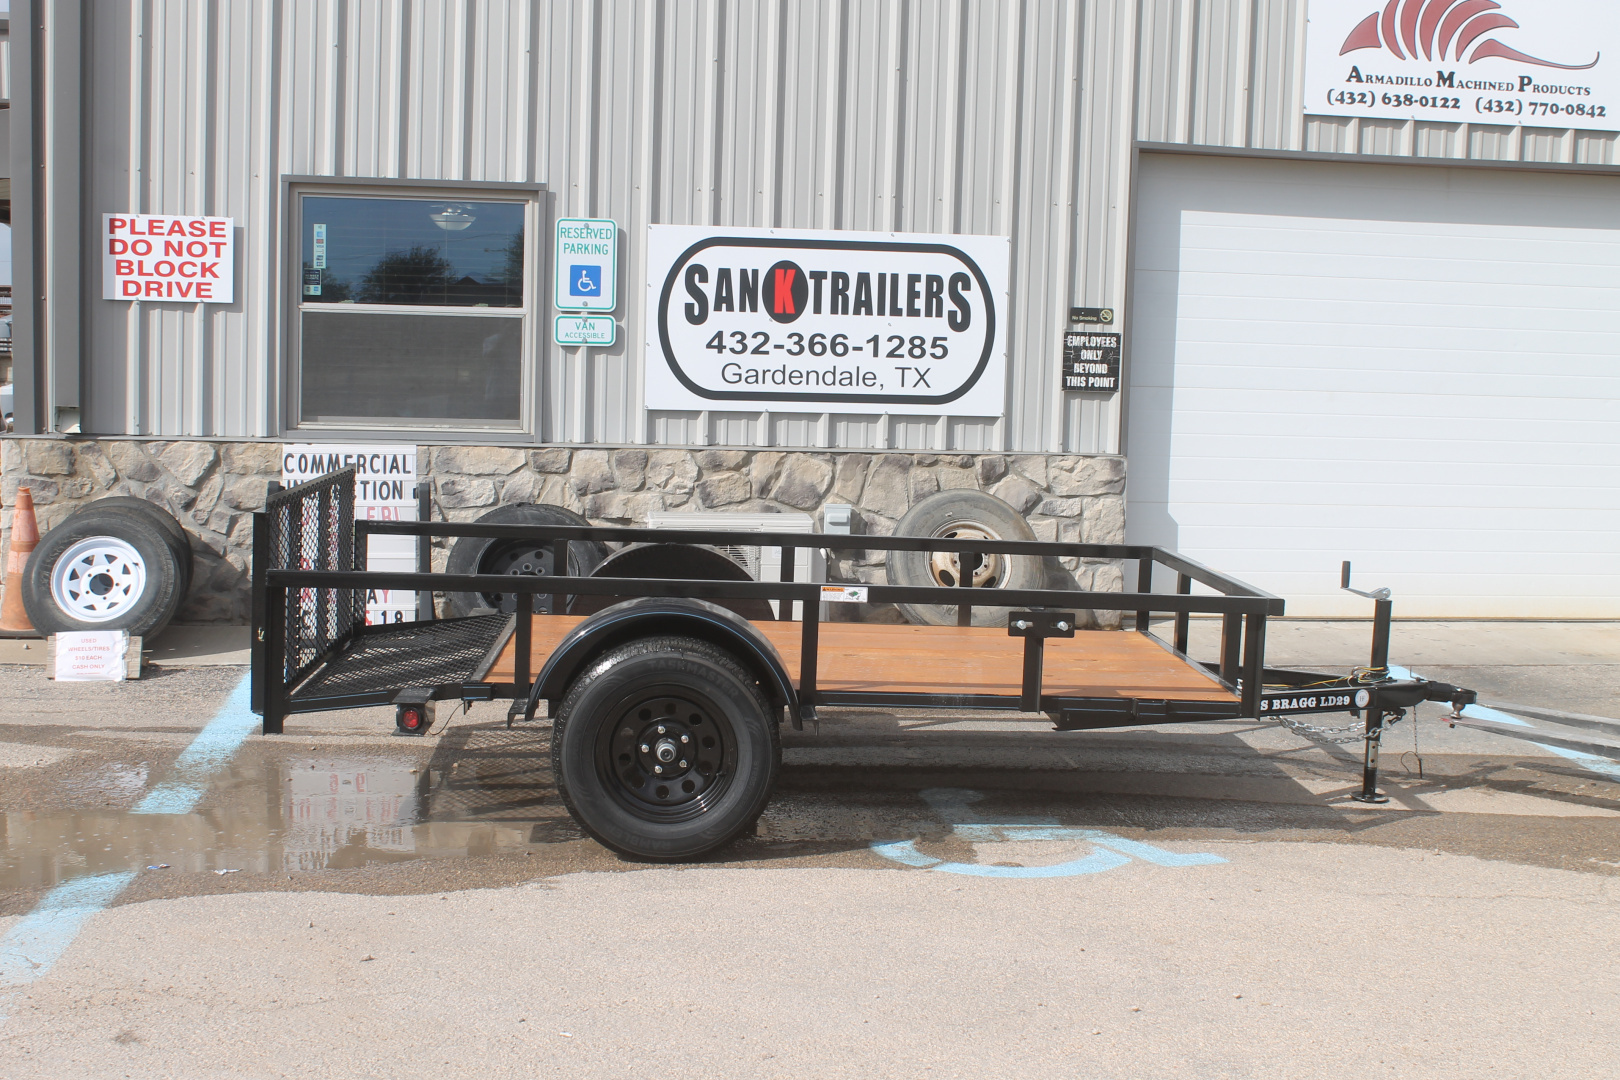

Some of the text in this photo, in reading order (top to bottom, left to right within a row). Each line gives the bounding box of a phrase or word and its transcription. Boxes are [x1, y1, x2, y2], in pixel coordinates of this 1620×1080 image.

[1345, 65, 1591, 96] ARMADILLO MACHINED PRODUCTS
[1326, 88, 1607, 118] (432) 638-0122 (432) 770-0842
[108, 217, 227, 238] PLEASE
[560, 227, 613, 240] RESERVED
[108, 238, 228, 259] DO NOT
[563, 243, 609, 255] PARKING
[115, 259, 220, 279] BLOCK
[122, 280, 213, 299] DRIVE
[575, 322, 596, 331] VAN
[705, 330, 949, 360] 432-366-1285
[1067, 335, 1117, 348] EMPLOYEES
[1080, 349, 1103, 361] ONLY
[721, 362, 932, 391] Gardendale, TX
[1073, 363, 1108, 374] BEYOND
[1066, 376, 1115, 388] THIS POINT
[647, 659, 739, 698] TASKMASTER
[1271, 697, 1317, 710] BRAGG
[1319, 695, 1351, 707] LD29
